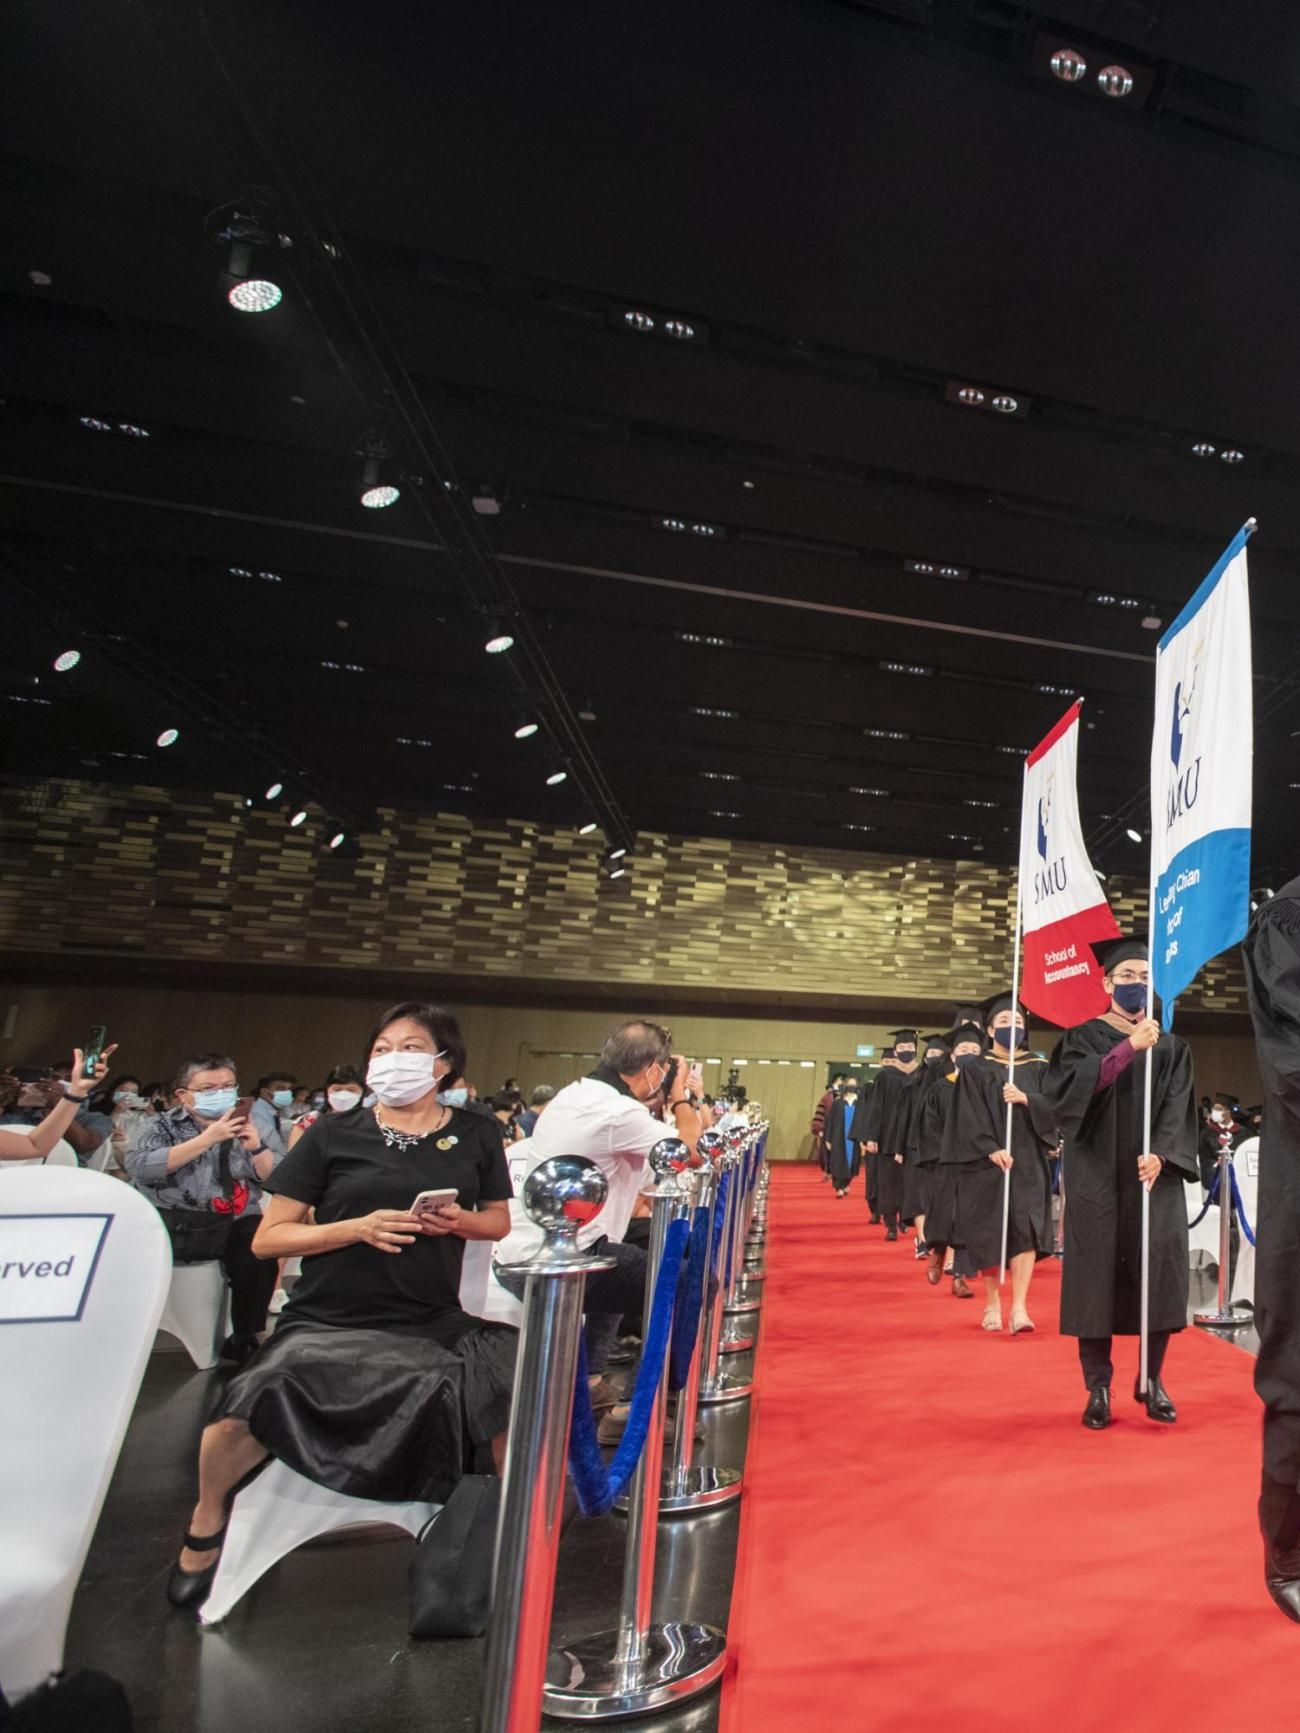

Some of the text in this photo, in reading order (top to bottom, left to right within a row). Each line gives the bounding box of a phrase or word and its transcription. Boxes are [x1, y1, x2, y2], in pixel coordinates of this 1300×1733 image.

[1034, 856, 1067, 904] SMU
[1176, 868, 1201, 893] Chian
[1043, 943, 1077, 966] School of
[0, 1254, 75, 1279] rved
